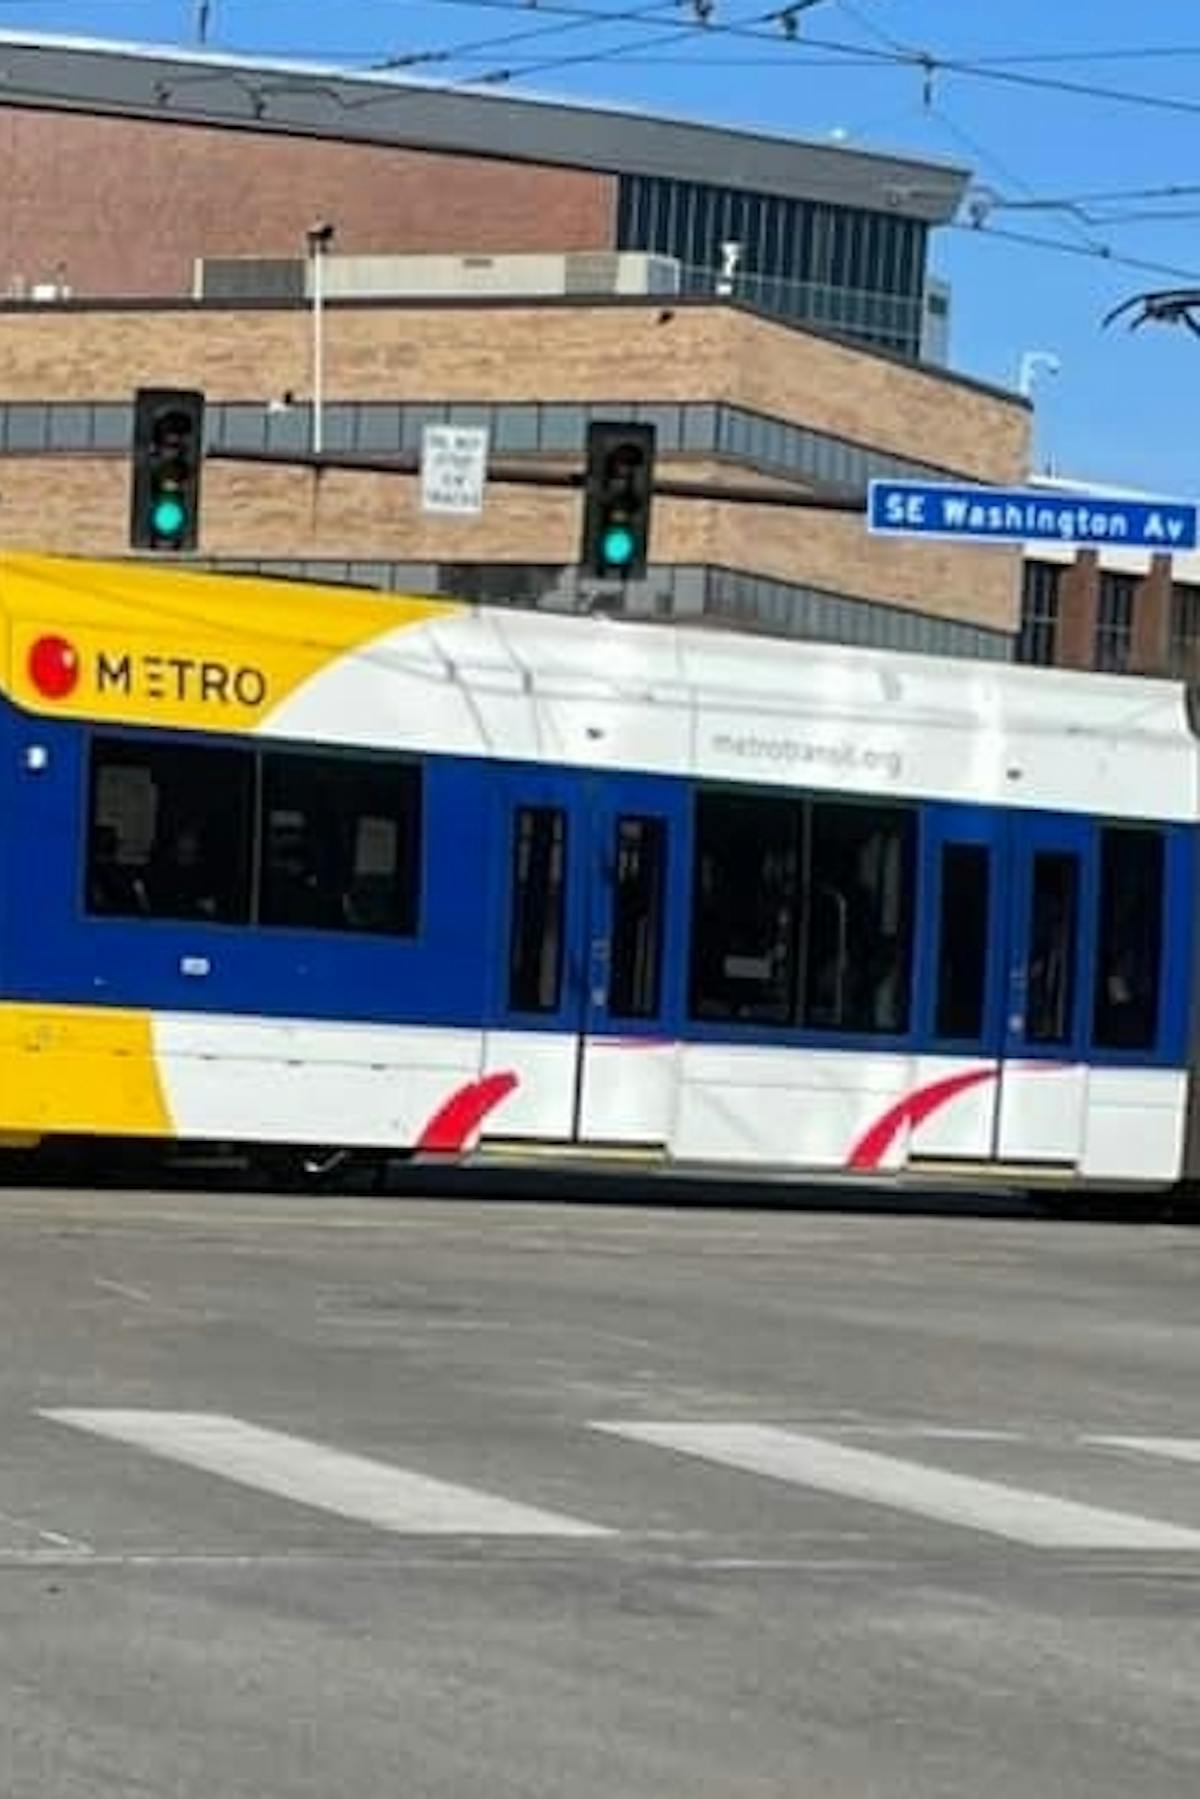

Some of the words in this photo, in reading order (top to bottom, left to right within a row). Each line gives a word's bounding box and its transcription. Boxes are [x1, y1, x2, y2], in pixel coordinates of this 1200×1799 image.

[885, 493, 926, 524] SE
[942, 498, 1130, 540] Washington
[1142, 512, 1185, 540] Av
[97, 652, 267, 707] METRO
[711, 731, 902, 780] metrotransit.org
